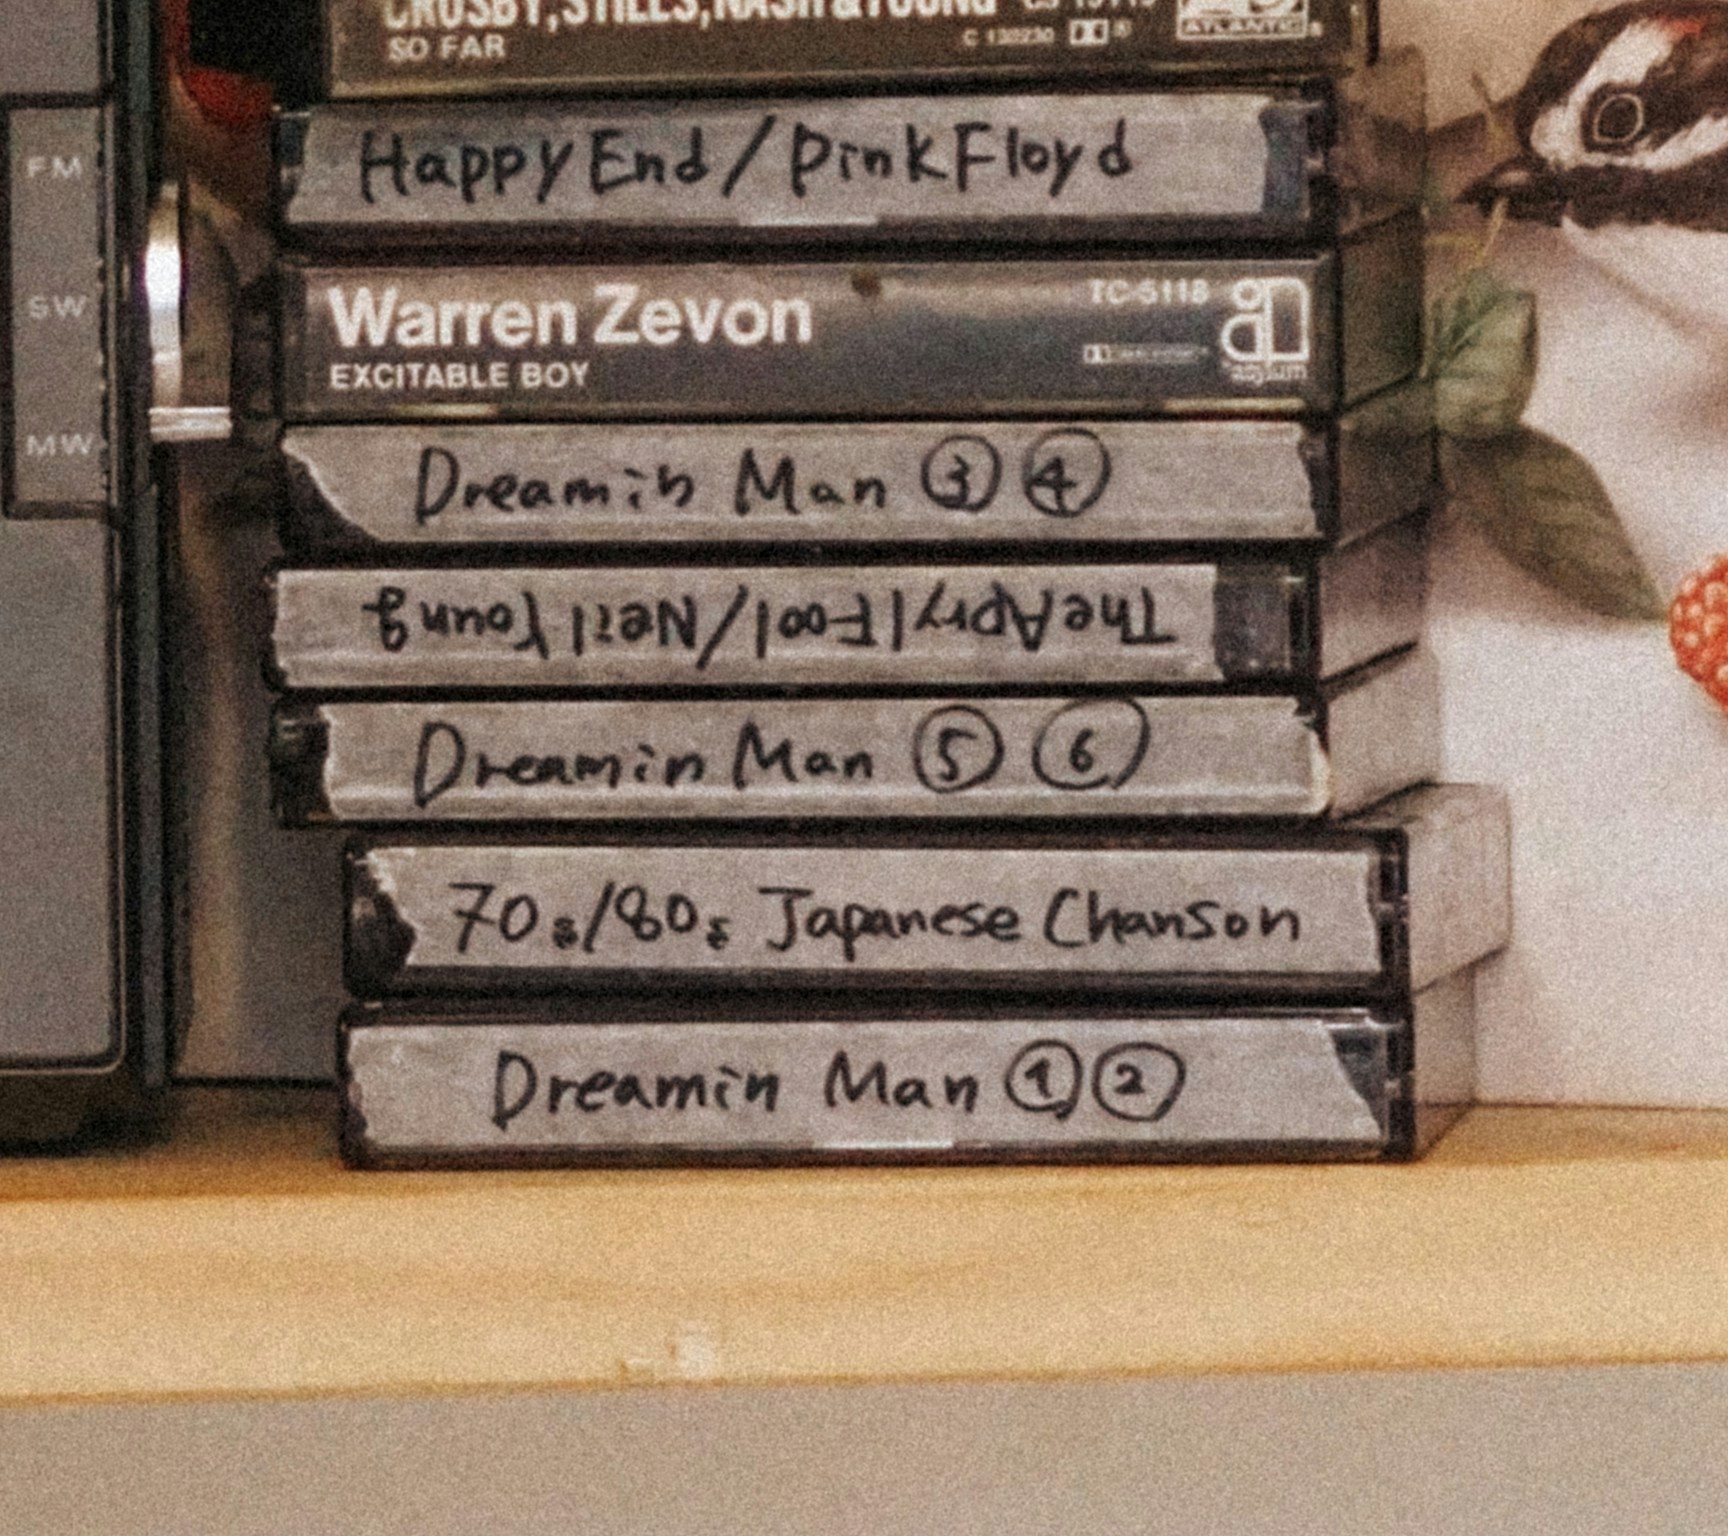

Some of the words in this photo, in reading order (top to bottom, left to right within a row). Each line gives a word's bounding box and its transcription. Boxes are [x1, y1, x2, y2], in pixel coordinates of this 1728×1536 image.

[388, 35, 429, 62] SO
[439, 33, 506, 60] FAR
[26, 156, 83, 180] FM
[28, 294, 89, 320] SW
[327, 285, 577, 348] Warren
[593, 282, 813, 346] Zevon
[329, 362, 509, 389] EXCITABLE
[520, 361, 590, 388] BOY
[26, 432, 94, 458] MW
[413, 446, 695, 525] Dreamin
[734, 448, 887, 515] Man
[362, 586, 551, 660] Young
[413, 719, 705, 808] Dreamin
[732, 718, 875, 790] Man
[758, 885, 1022, 962] Japanese
[1042, 888, 1304, 948] Chanson
[491, 1050, 782, 1131] Dreamin
[823, 1050, 981, 1115] Man
